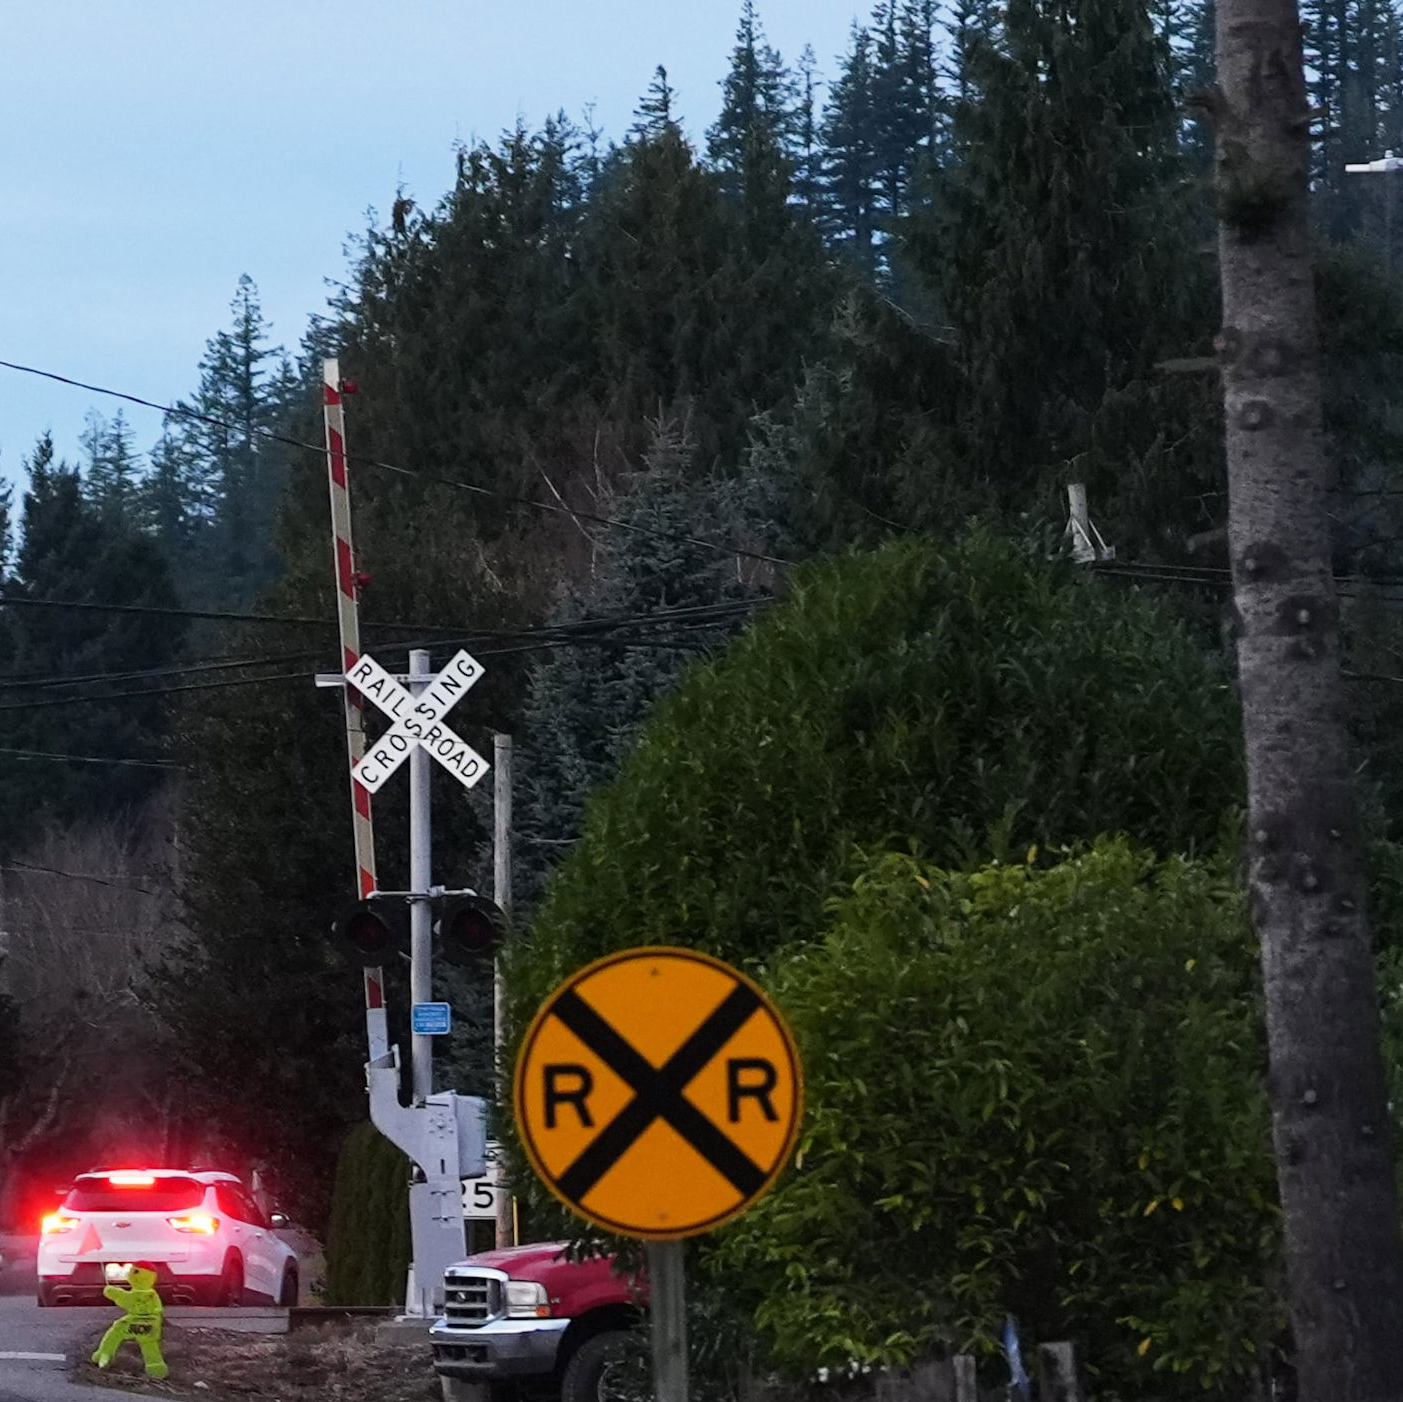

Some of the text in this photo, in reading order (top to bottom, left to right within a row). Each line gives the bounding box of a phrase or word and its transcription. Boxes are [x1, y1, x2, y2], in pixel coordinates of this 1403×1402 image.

[354, 663, 479, 778] RAIL ROAD
[361, 660, 475, 783] CROSSING
[543, 1058, 779, 1128] R R
[462, 1183, 494, 1208] 5
